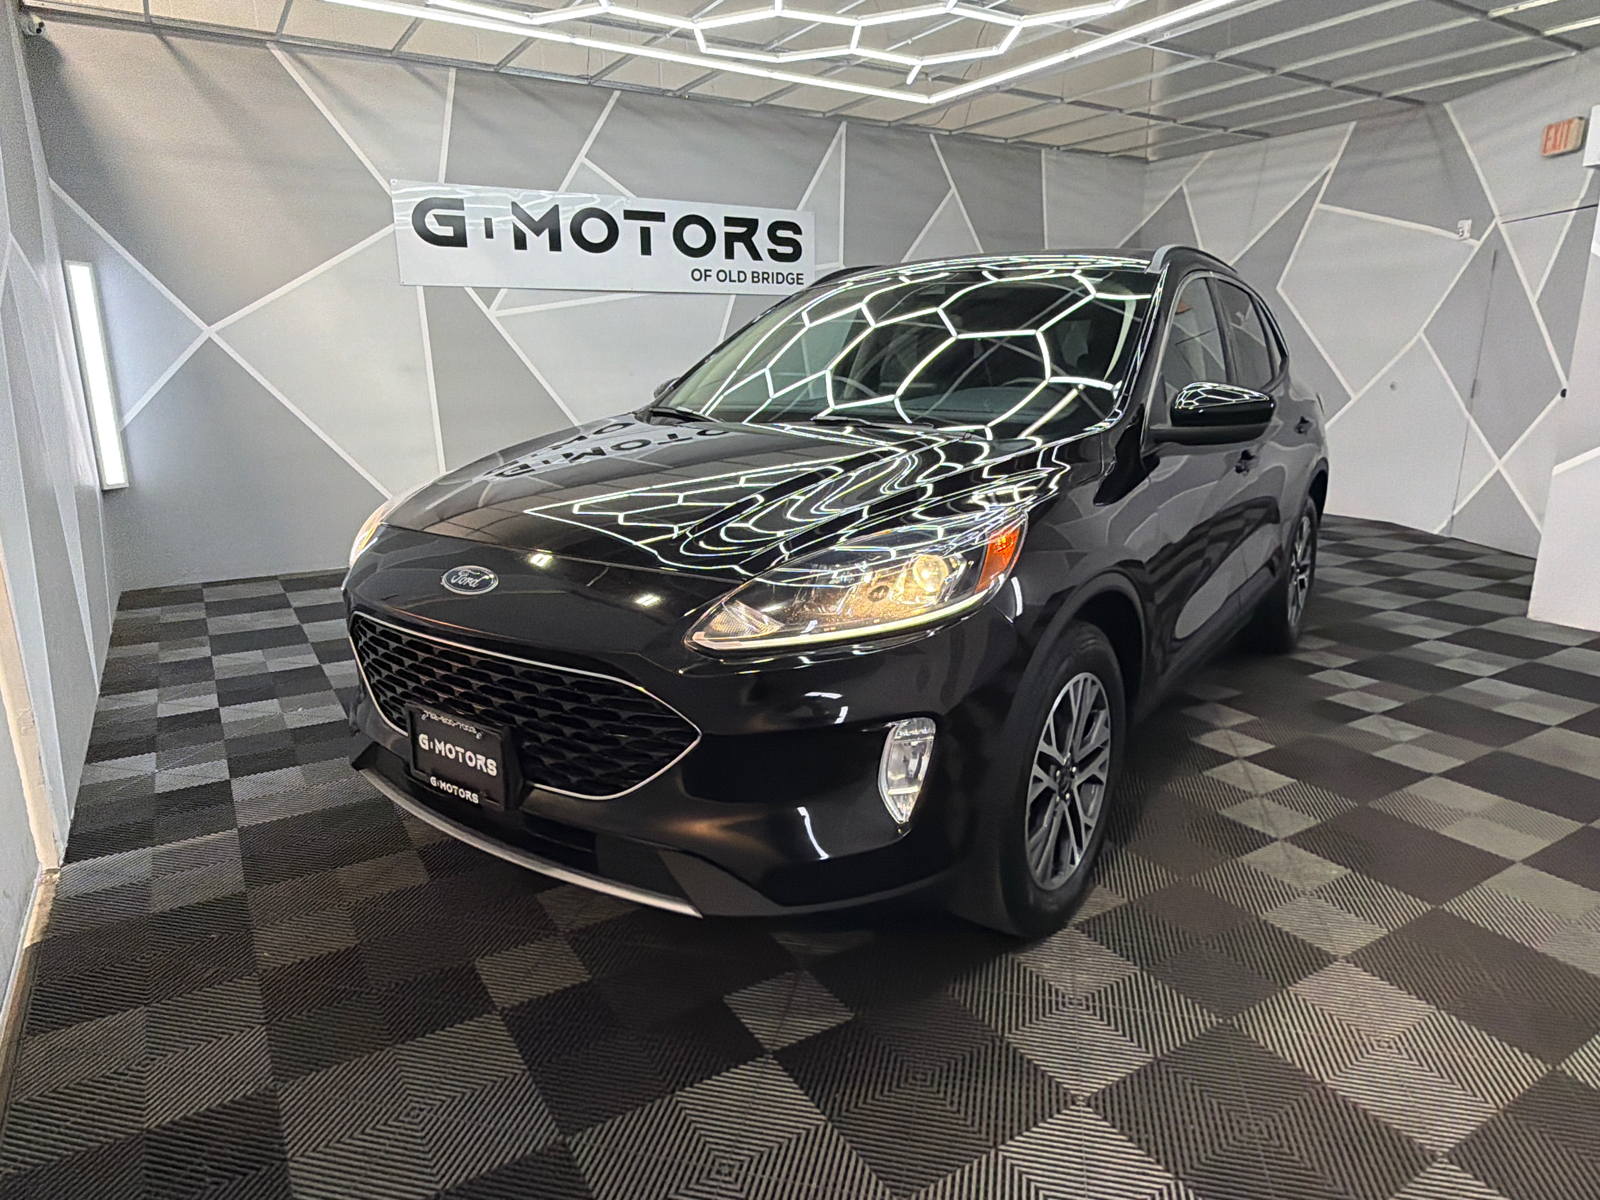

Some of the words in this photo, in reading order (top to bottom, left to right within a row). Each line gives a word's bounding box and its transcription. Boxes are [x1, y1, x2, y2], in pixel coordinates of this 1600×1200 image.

[1542, 119, 1575, 154] EXIT
[690, 268, 712, 282] OF
[716, 269, 747, 283] OLD
[751, 271, 804, 285] BRIDGE
